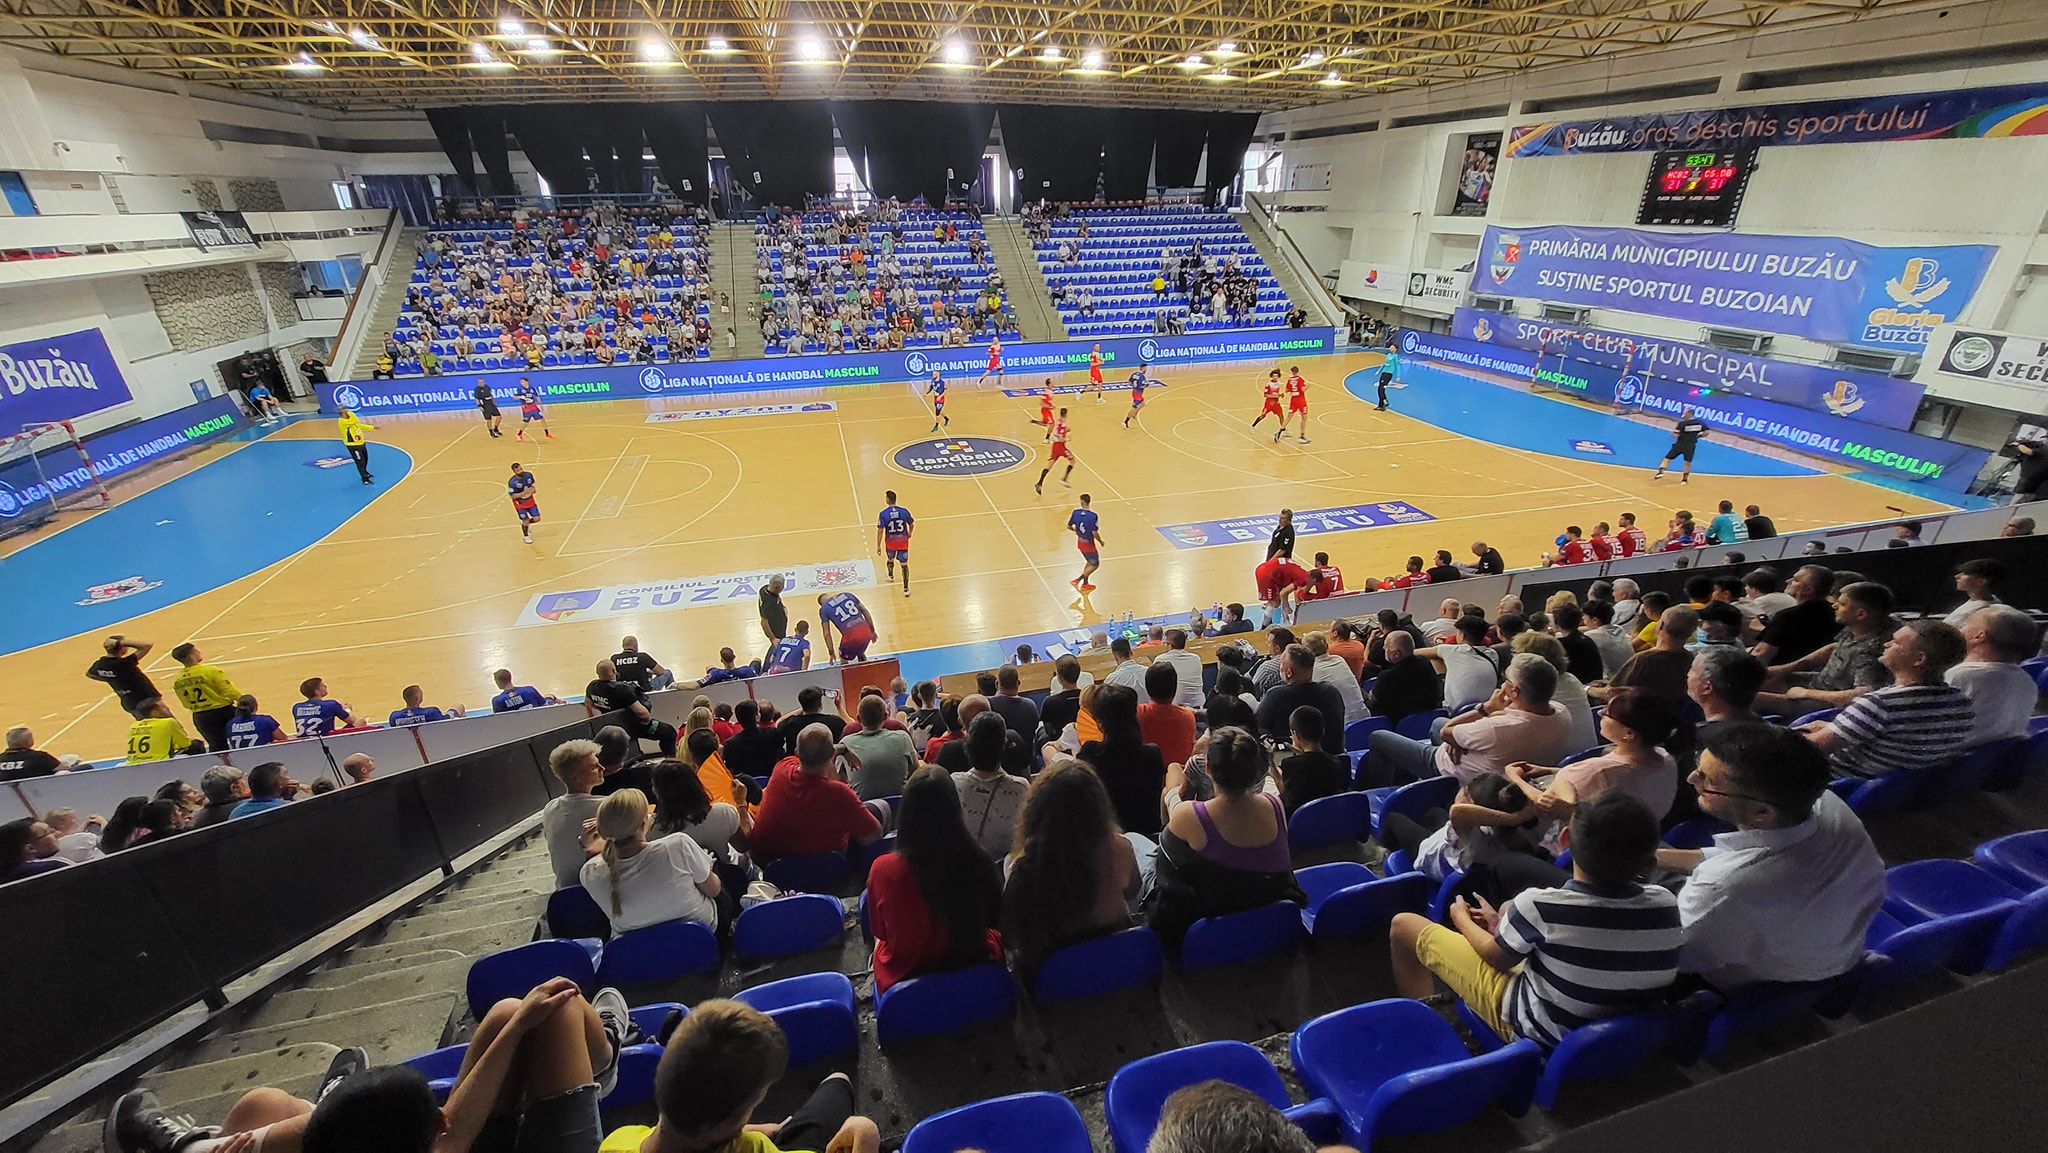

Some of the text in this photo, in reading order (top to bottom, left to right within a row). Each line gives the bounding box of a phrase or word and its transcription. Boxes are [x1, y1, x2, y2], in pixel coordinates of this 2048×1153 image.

[1783, 102, 1931, 142] sportului
[1529, 237, 1857, 281] PRIMĂRIA MUNICIPIULUI BUZĂU
[1424, 286, 1460, 299] SECURITY
[1537, 269, 1813, 316] SUSȚINE SPORTUL BUZOIAN
[1869, 308, 1945, 326] Gloria
[1155, 339, 1323, 358] LIGA NAȚIONALĂ DE HANDBAL MASCULIN
[0, 347, 98, 396] Buzău
[925, 360, 948, 372] LIGA
[1007, 357, 1020, 367] DE
[1021, 354, 1066, 366] HANDBAL
[1414, 343, 1589, 390] LIGA NAȚIONALĂ DE HANDBAL MASCULIN
[1638, 342, 1773, 386] MUNICIPAL
[663, 366, 879, 389] LIGA NAȚIONALĂ DE HANDBAL MASCULIN
[360, 396, 390, 407] LIGA
[393, 389, 467, 407] NAȚIONALĂ
[547, 382, 611, 395] MASCULIN
[1744, 417, 1767, 433] DE
[14, 483, 50, 506] LIGA
[119, 449, 139, 465] DE
[135, 430, 187, 458] HANDBAL
[183, 413, 234, 440] MASCULIN
[909, 450, 1013, 466] Handbalul
[912, 463, 956, 472] Sport
[888, 519, 904, 533] 13
[616, 580, 703, 596] CONSILIUL
[1331, 576, 1339, 591] 7
[835, 600, 859, 622] 18
[616, 656, 638, 666] HCBZ
[779, 646, 791, 663] 7
[295, 717, 323, 737] 32
[127, 736, 151, 755] 16
[0, 760, 25, 771] CBZ
